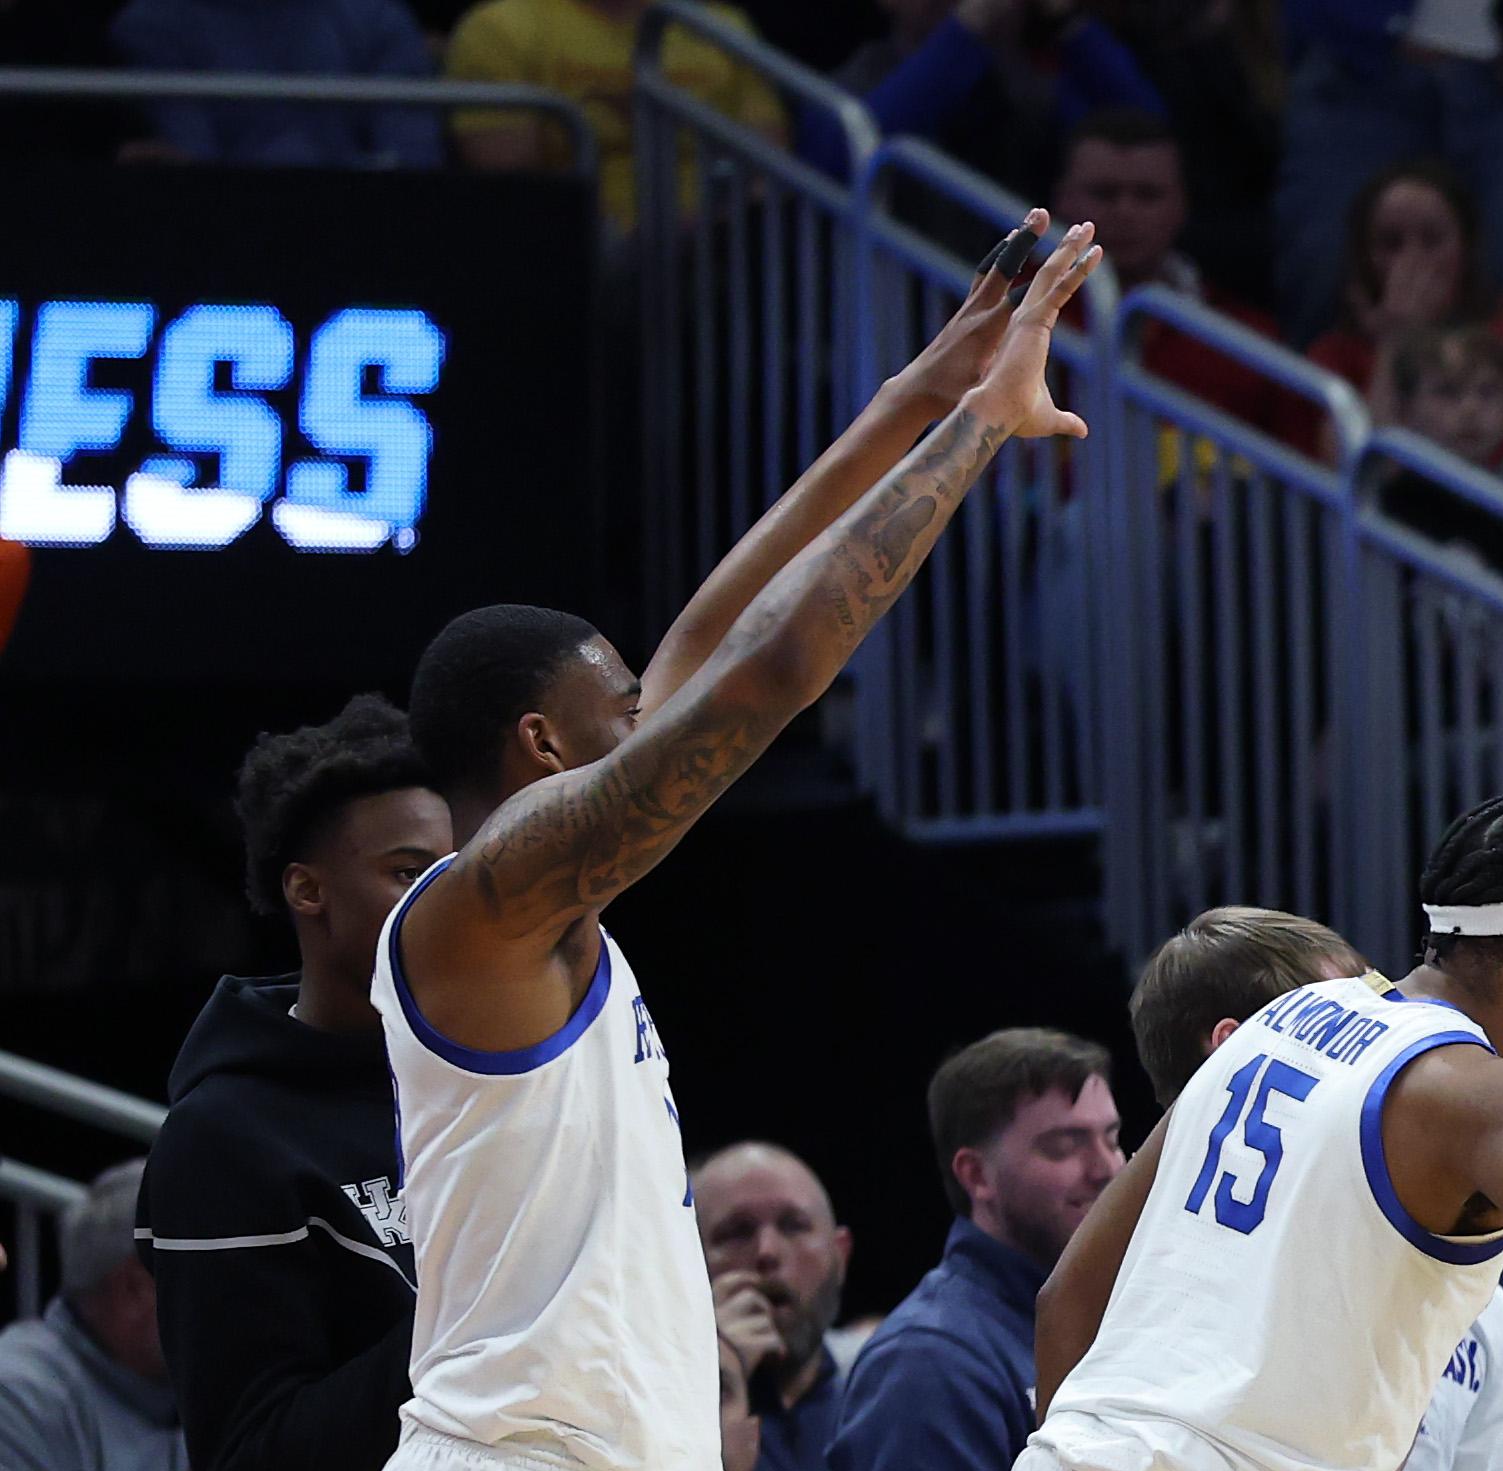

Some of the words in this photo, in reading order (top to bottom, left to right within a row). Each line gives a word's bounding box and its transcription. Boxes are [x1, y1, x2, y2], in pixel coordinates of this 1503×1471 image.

[0, 297, 446, 554] ESS
[1257, 988, 1390, 1065] ALMONOR
[1185, 1053, 1321, 1236] 15
